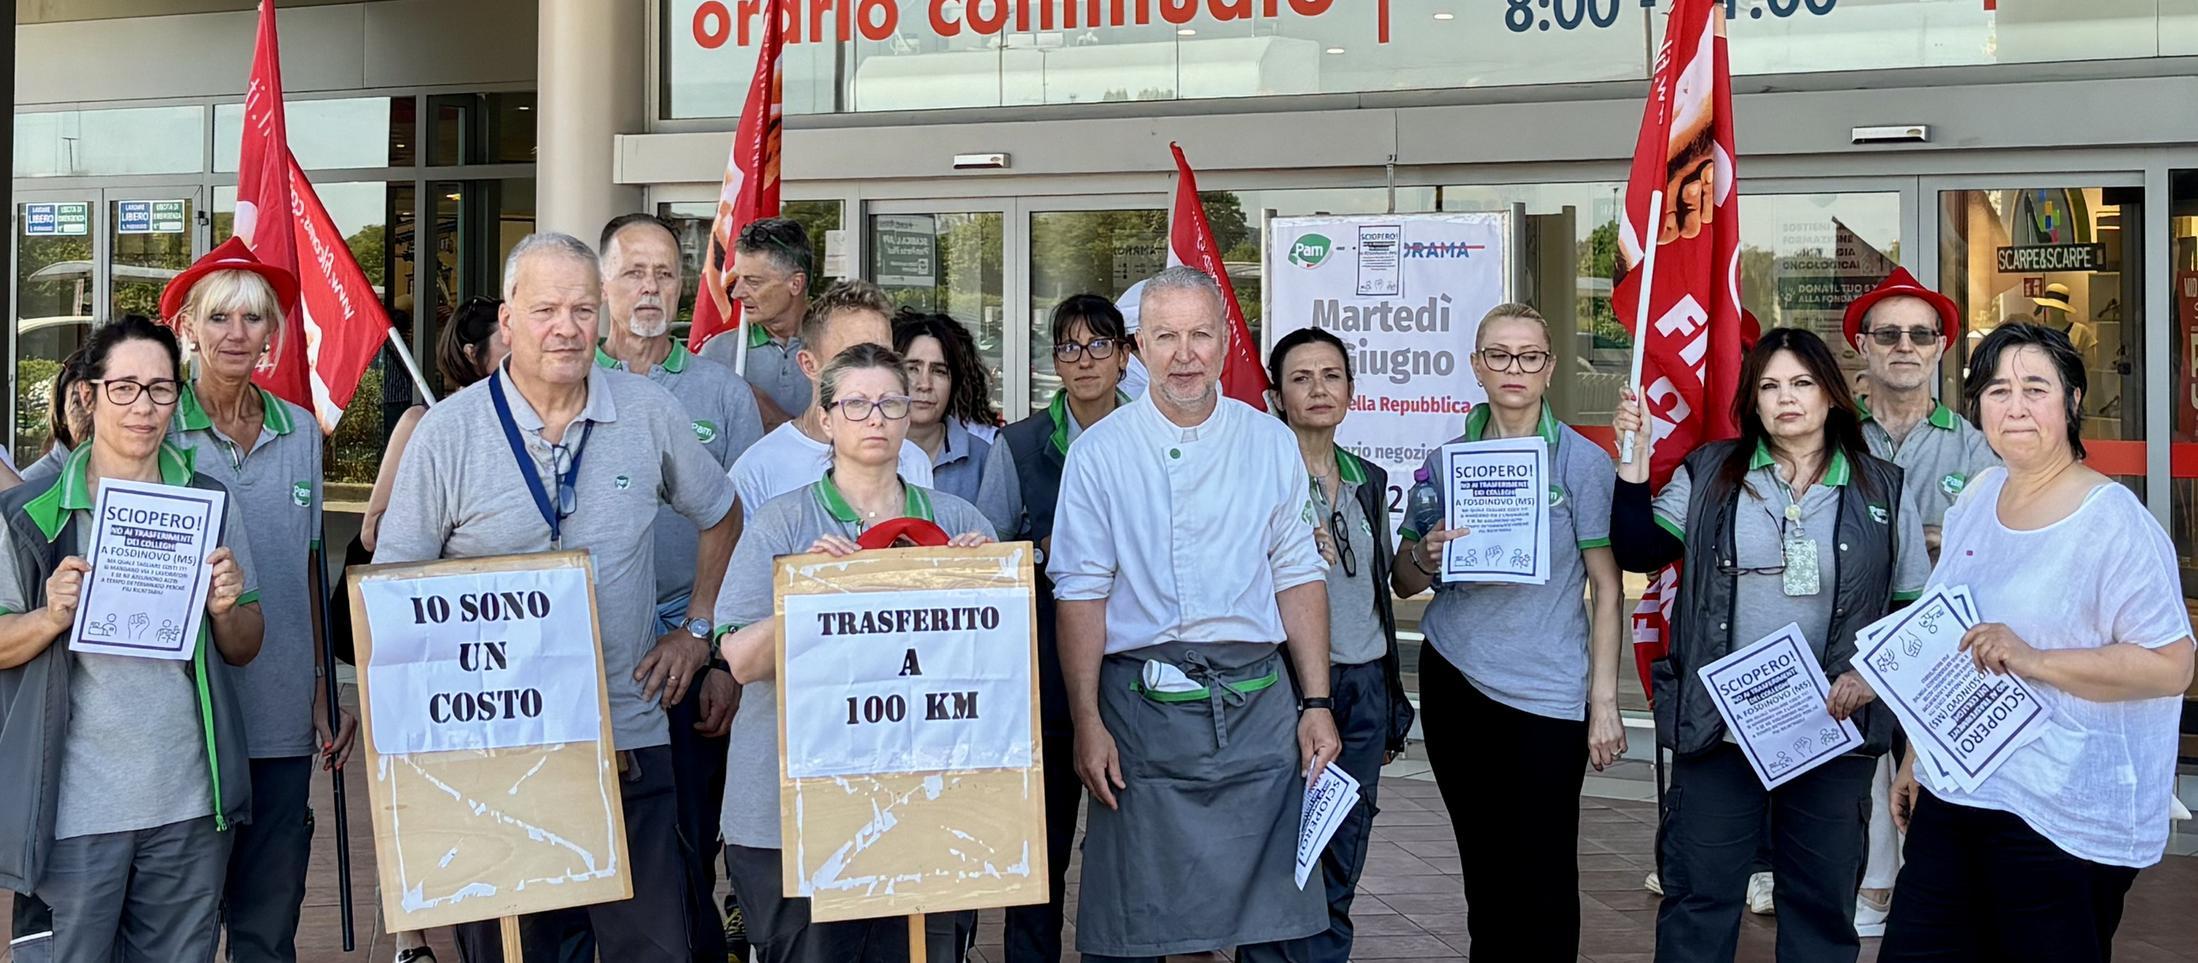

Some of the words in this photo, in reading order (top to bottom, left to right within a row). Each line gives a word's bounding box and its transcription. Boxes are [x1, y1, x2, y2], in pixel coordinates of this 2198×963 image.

[29, 215, 54, 223] LIBERO
[122, 212, 149, 221] LIBERO
[1296, 243, 1323, 257] Pam
[1998, 247, 2092, 270] SCARPE&SCARPE
[1312, 293, 1452, 332] Martedì
[1349, 396, 1375, 411] ella
[1380, 395, 1471, 415] Repubblica
[691, 422, 712, 436] Pam
[1455, 464, 1532, 478] SCIOPERO!
[106, 505, 202, 530] SCIOPERO!
[101, 545, 108, 553] A
[110, 546, 170, 561] FOSDINOVO
[173, 553, 196, 565] (MS)
[411, 596, 449, 624] IO
[460, 591, 550, 621] SONO
[818, 607, 999, 635] TRASFERITO
[460, 642, 506, 671] UN
[899, 649, 921, 676] A
[1718, 649, 1796, 696] SCIOPERO!
[430, 689, 542, 723] COSTO
[847, 695, 905, 724] 100
[926, 692, 978, 720] KM
[1954, 686, 2027, 760] SCIOPERO!
